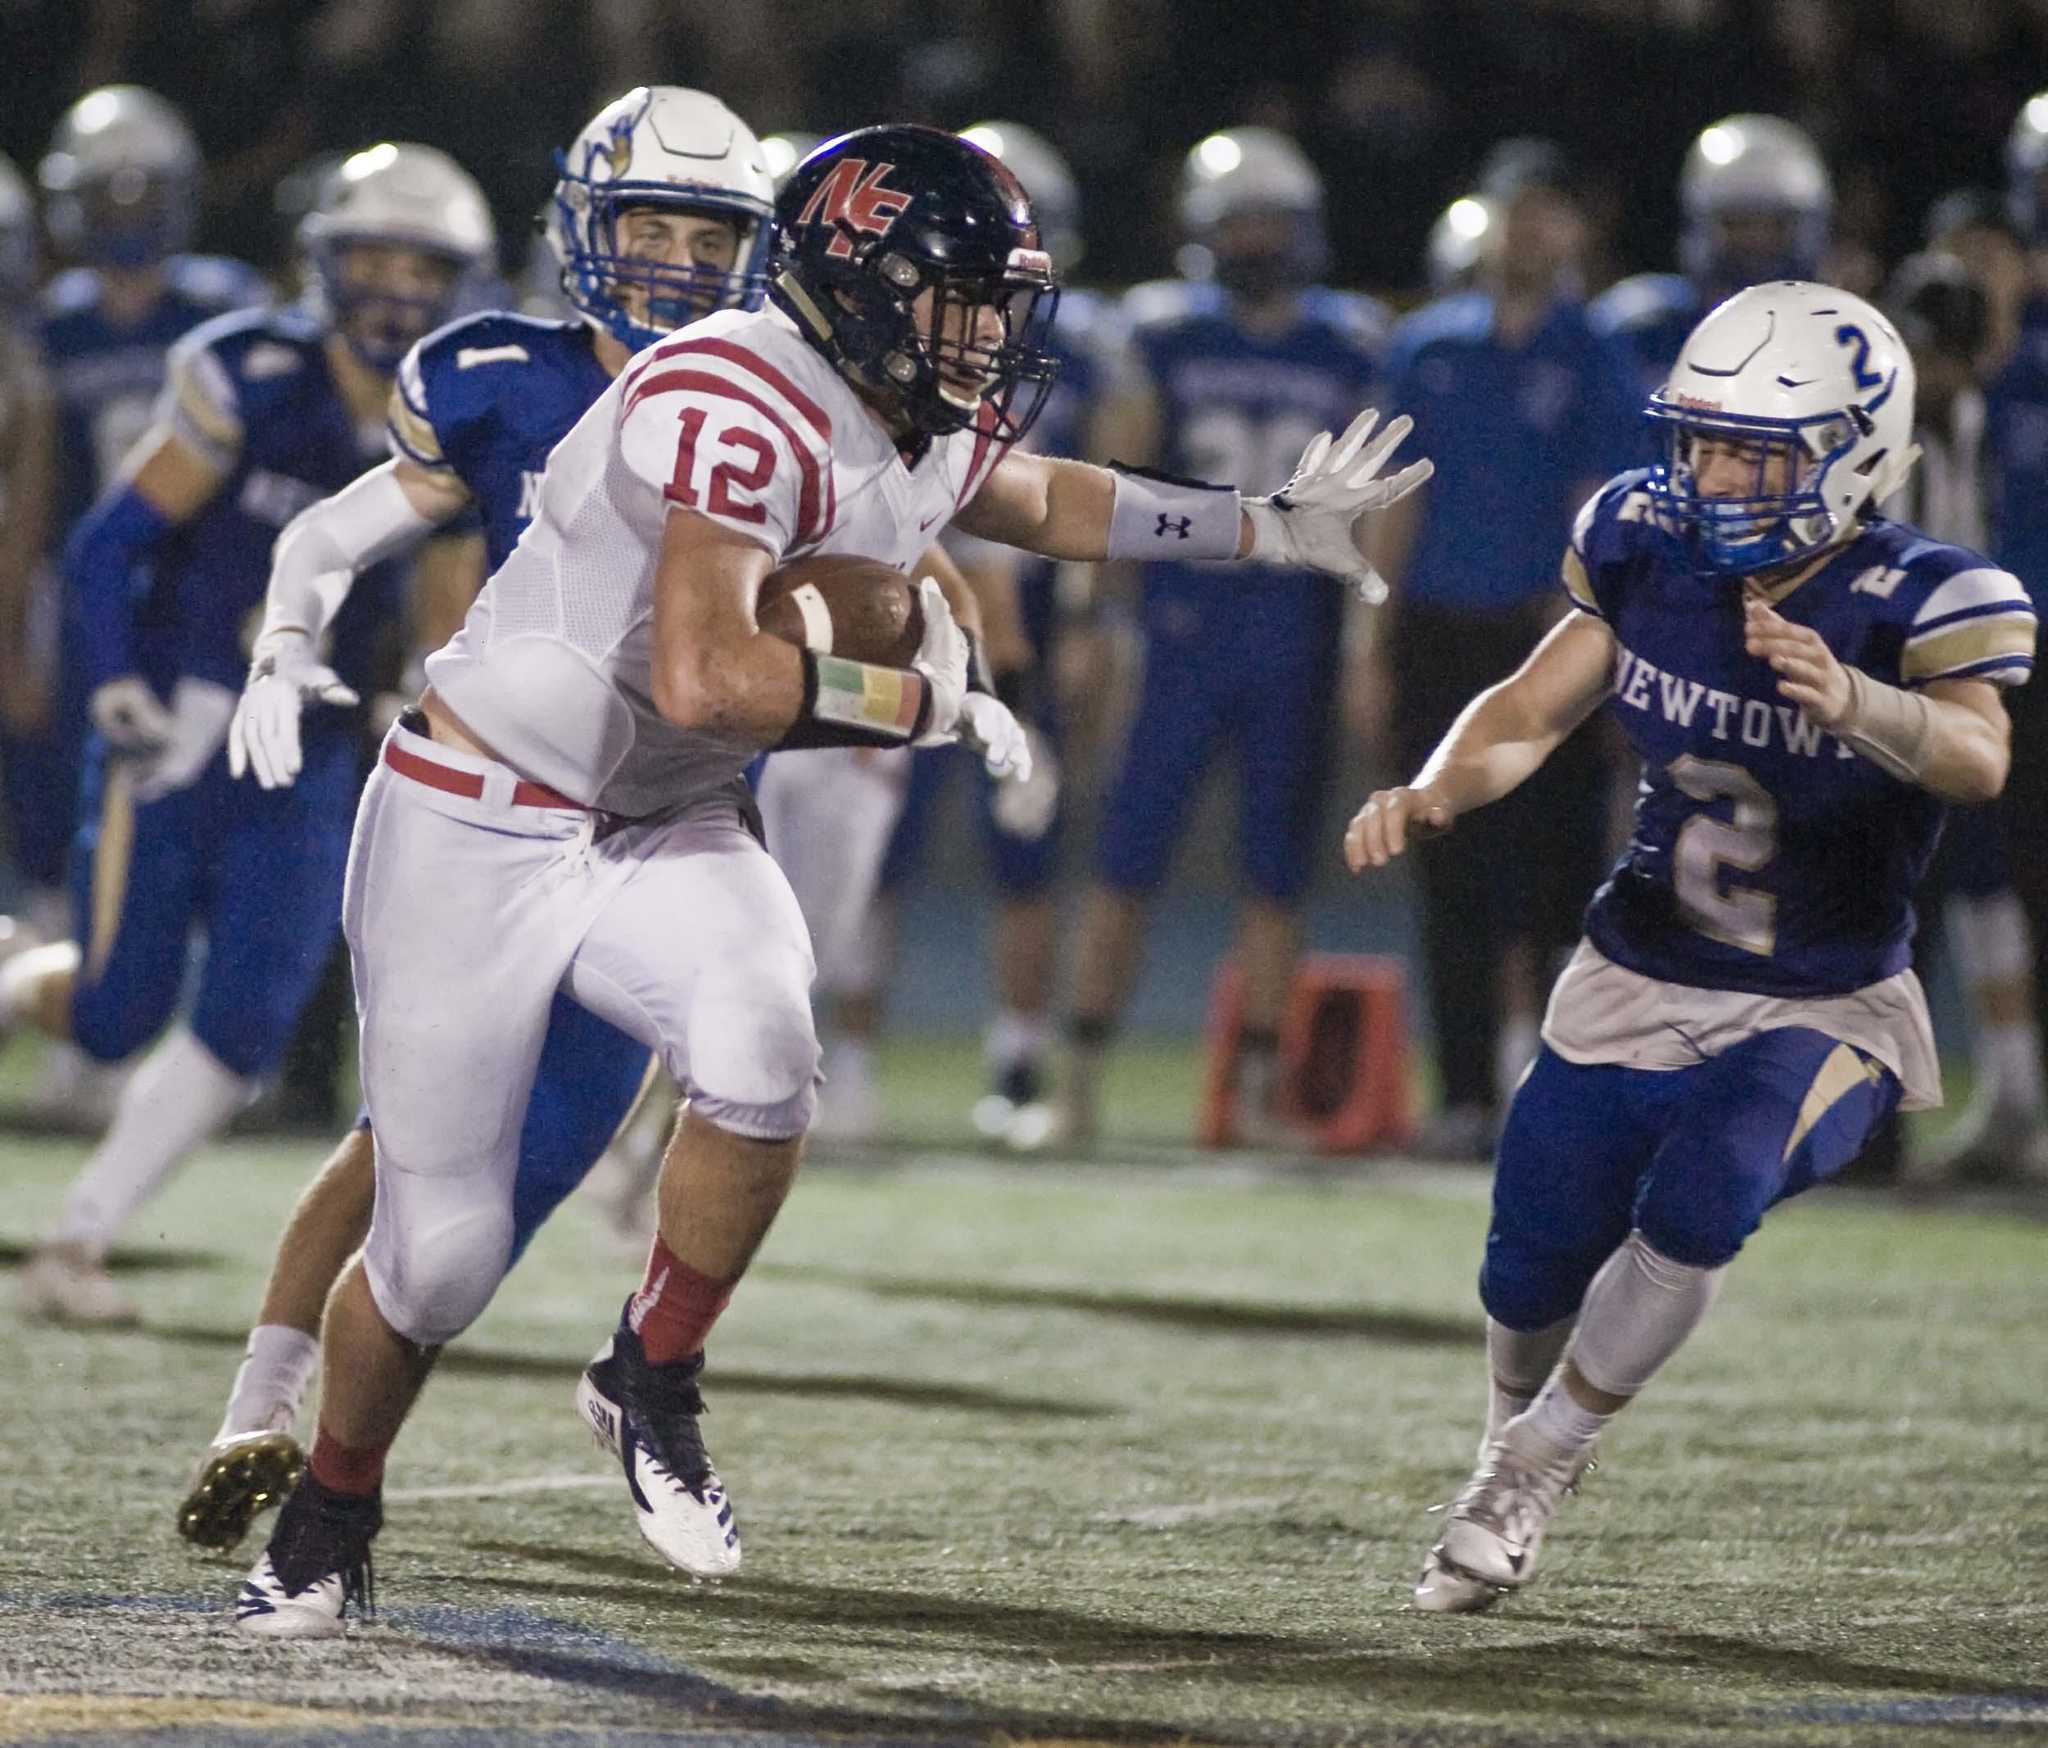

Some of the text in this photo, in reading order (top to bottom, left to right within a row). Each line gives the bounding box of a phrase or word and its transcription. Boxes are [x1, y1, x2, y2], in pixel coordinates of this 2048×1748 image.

[456, 345, 530, 369] 1
[1836, 324, 1883, 389] 2
[664, 407, 777, 525] 12
[1666, 752, 1778, 956] 2
